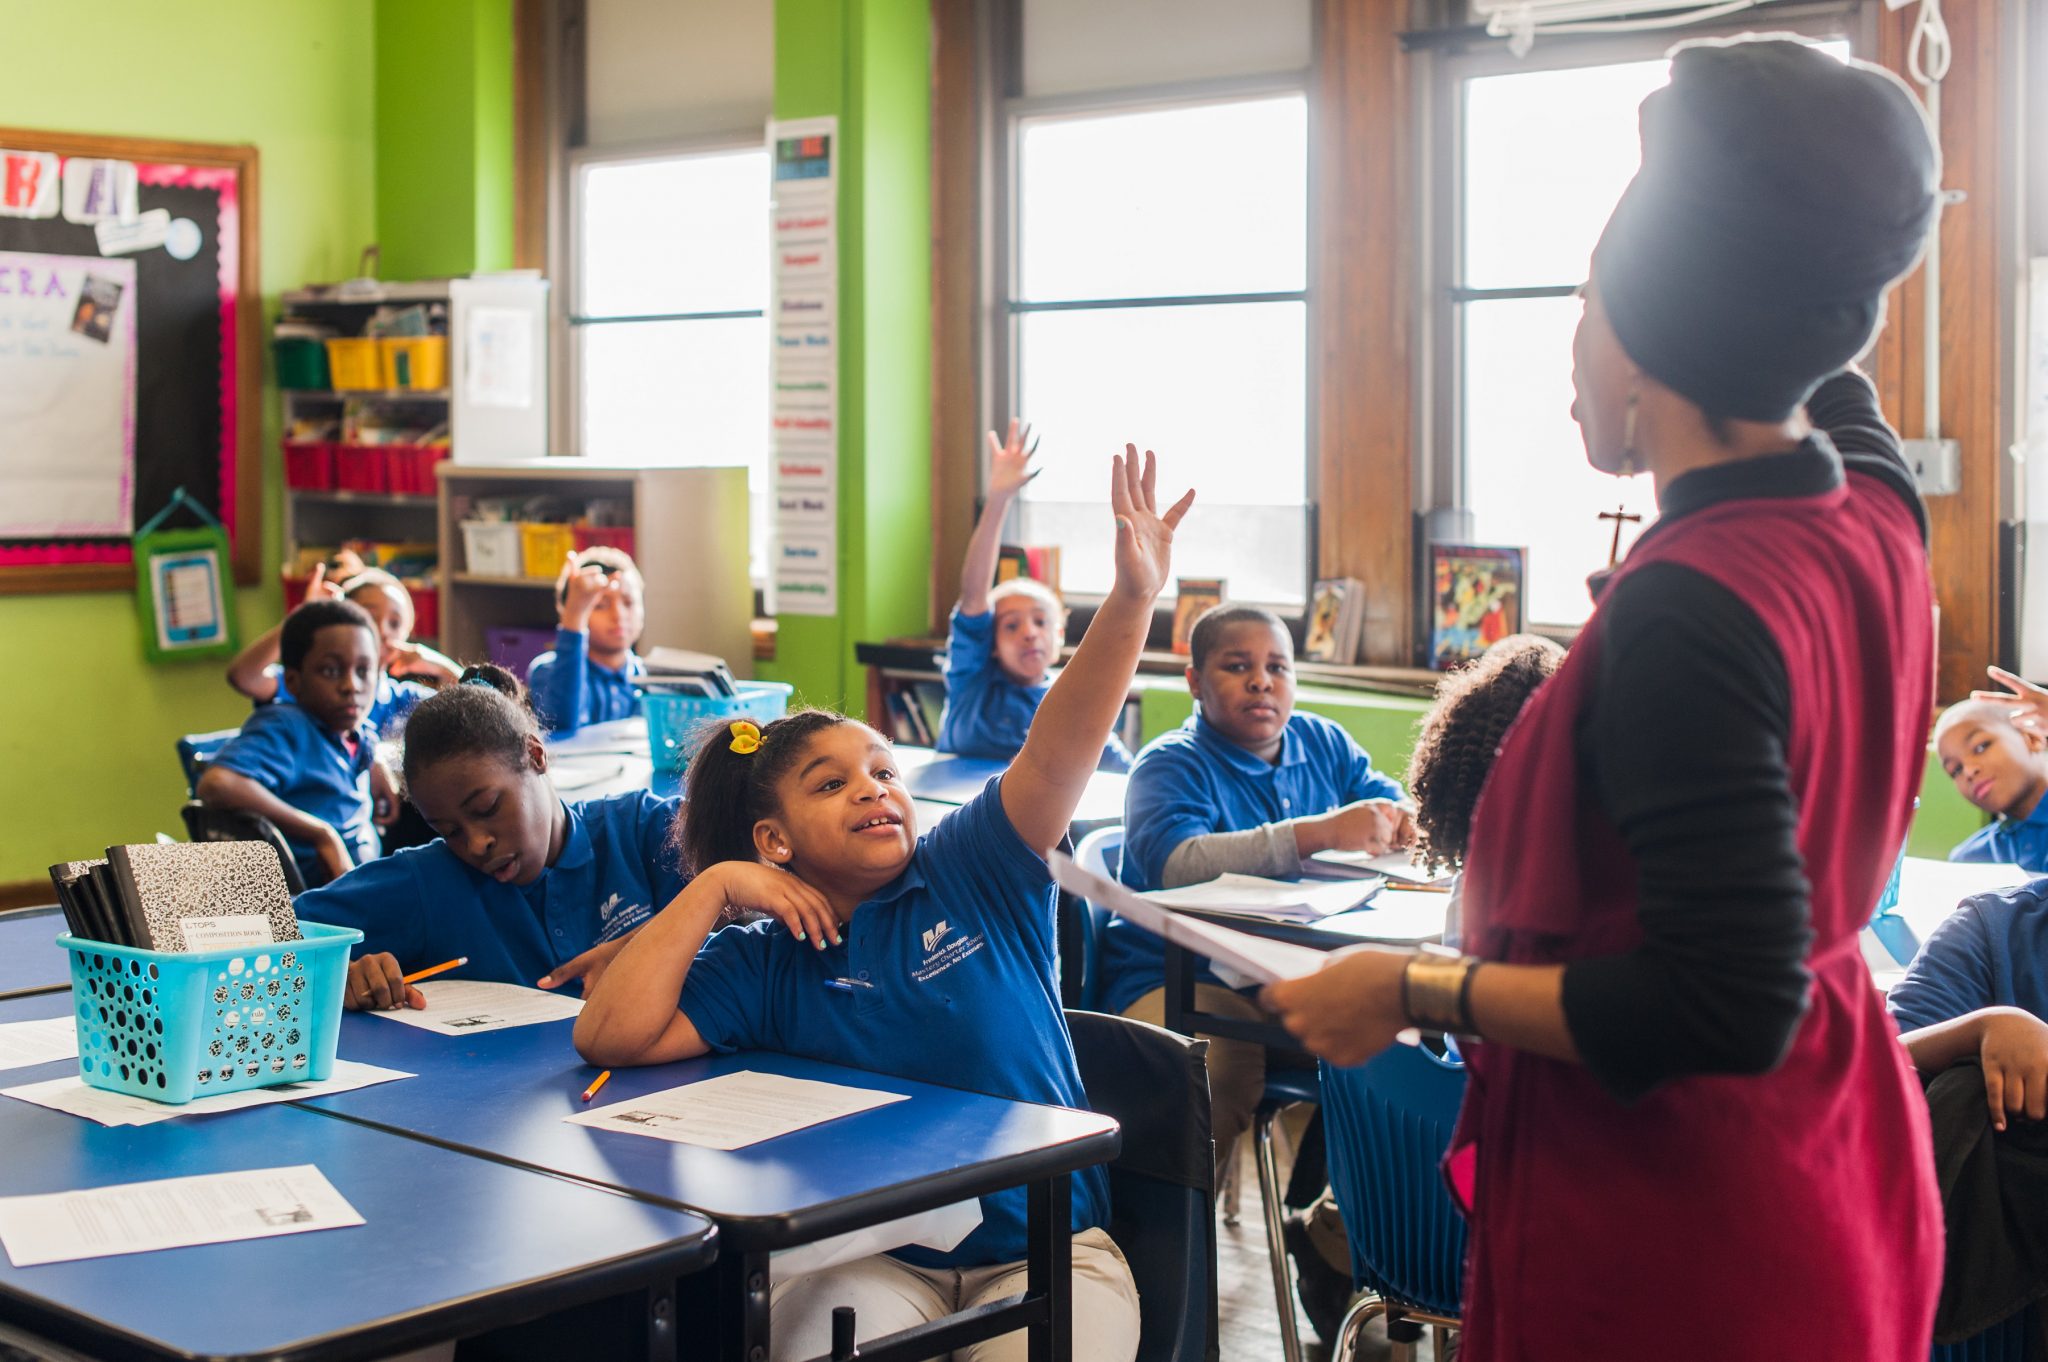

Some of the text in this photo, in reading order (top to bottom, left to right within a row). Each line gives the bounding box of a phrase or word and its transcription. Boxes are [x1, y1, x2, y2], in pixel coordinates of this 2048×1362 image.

[192, 921, 216, 929] TOPS
[195, 931, 242, 939] COMPOSITION
[952, 955, 962, 964] No
